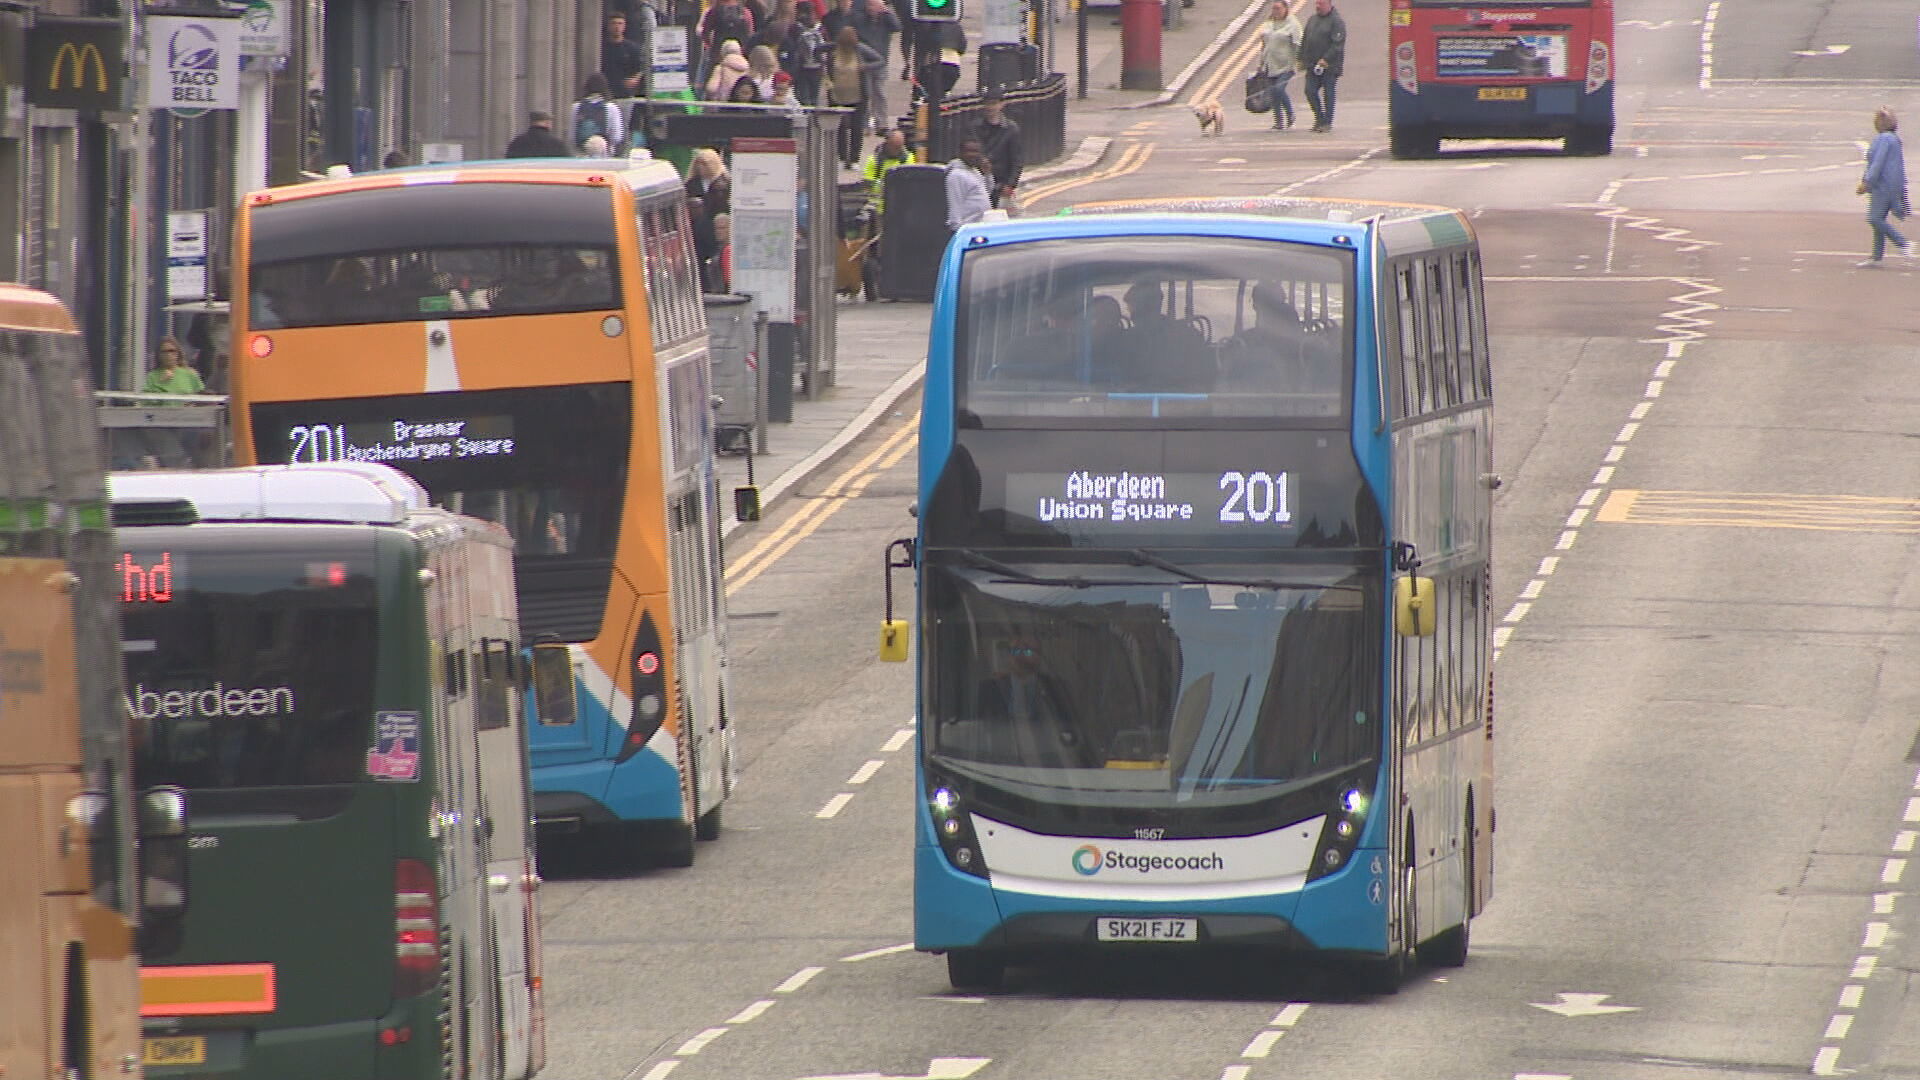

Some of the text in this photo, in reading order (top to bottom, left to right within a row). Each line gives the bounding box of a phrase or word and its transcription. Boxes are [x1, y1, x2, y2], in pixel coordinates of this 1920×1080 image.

[168, 71, 218, 86] TACO
[172, 87, 217, 102] BELL
[392, 420, 466, 442] Braemar
[288, 424, 347, 464] 201
[347, 437, 515, 464] Auchendryne Square
[1066, 471, 1165, 500] Aberdeen
[1219, 471, 1291, 522] 201
[1039, 498, 1193, 521] Union Square
[113, 551, 172, 603] hd
[1133, 828, 1166, 840] 11567
[1105, 851, 1224, 873] Stagecoach
[1108, 921, 1186, 938] SK21 FJZ
